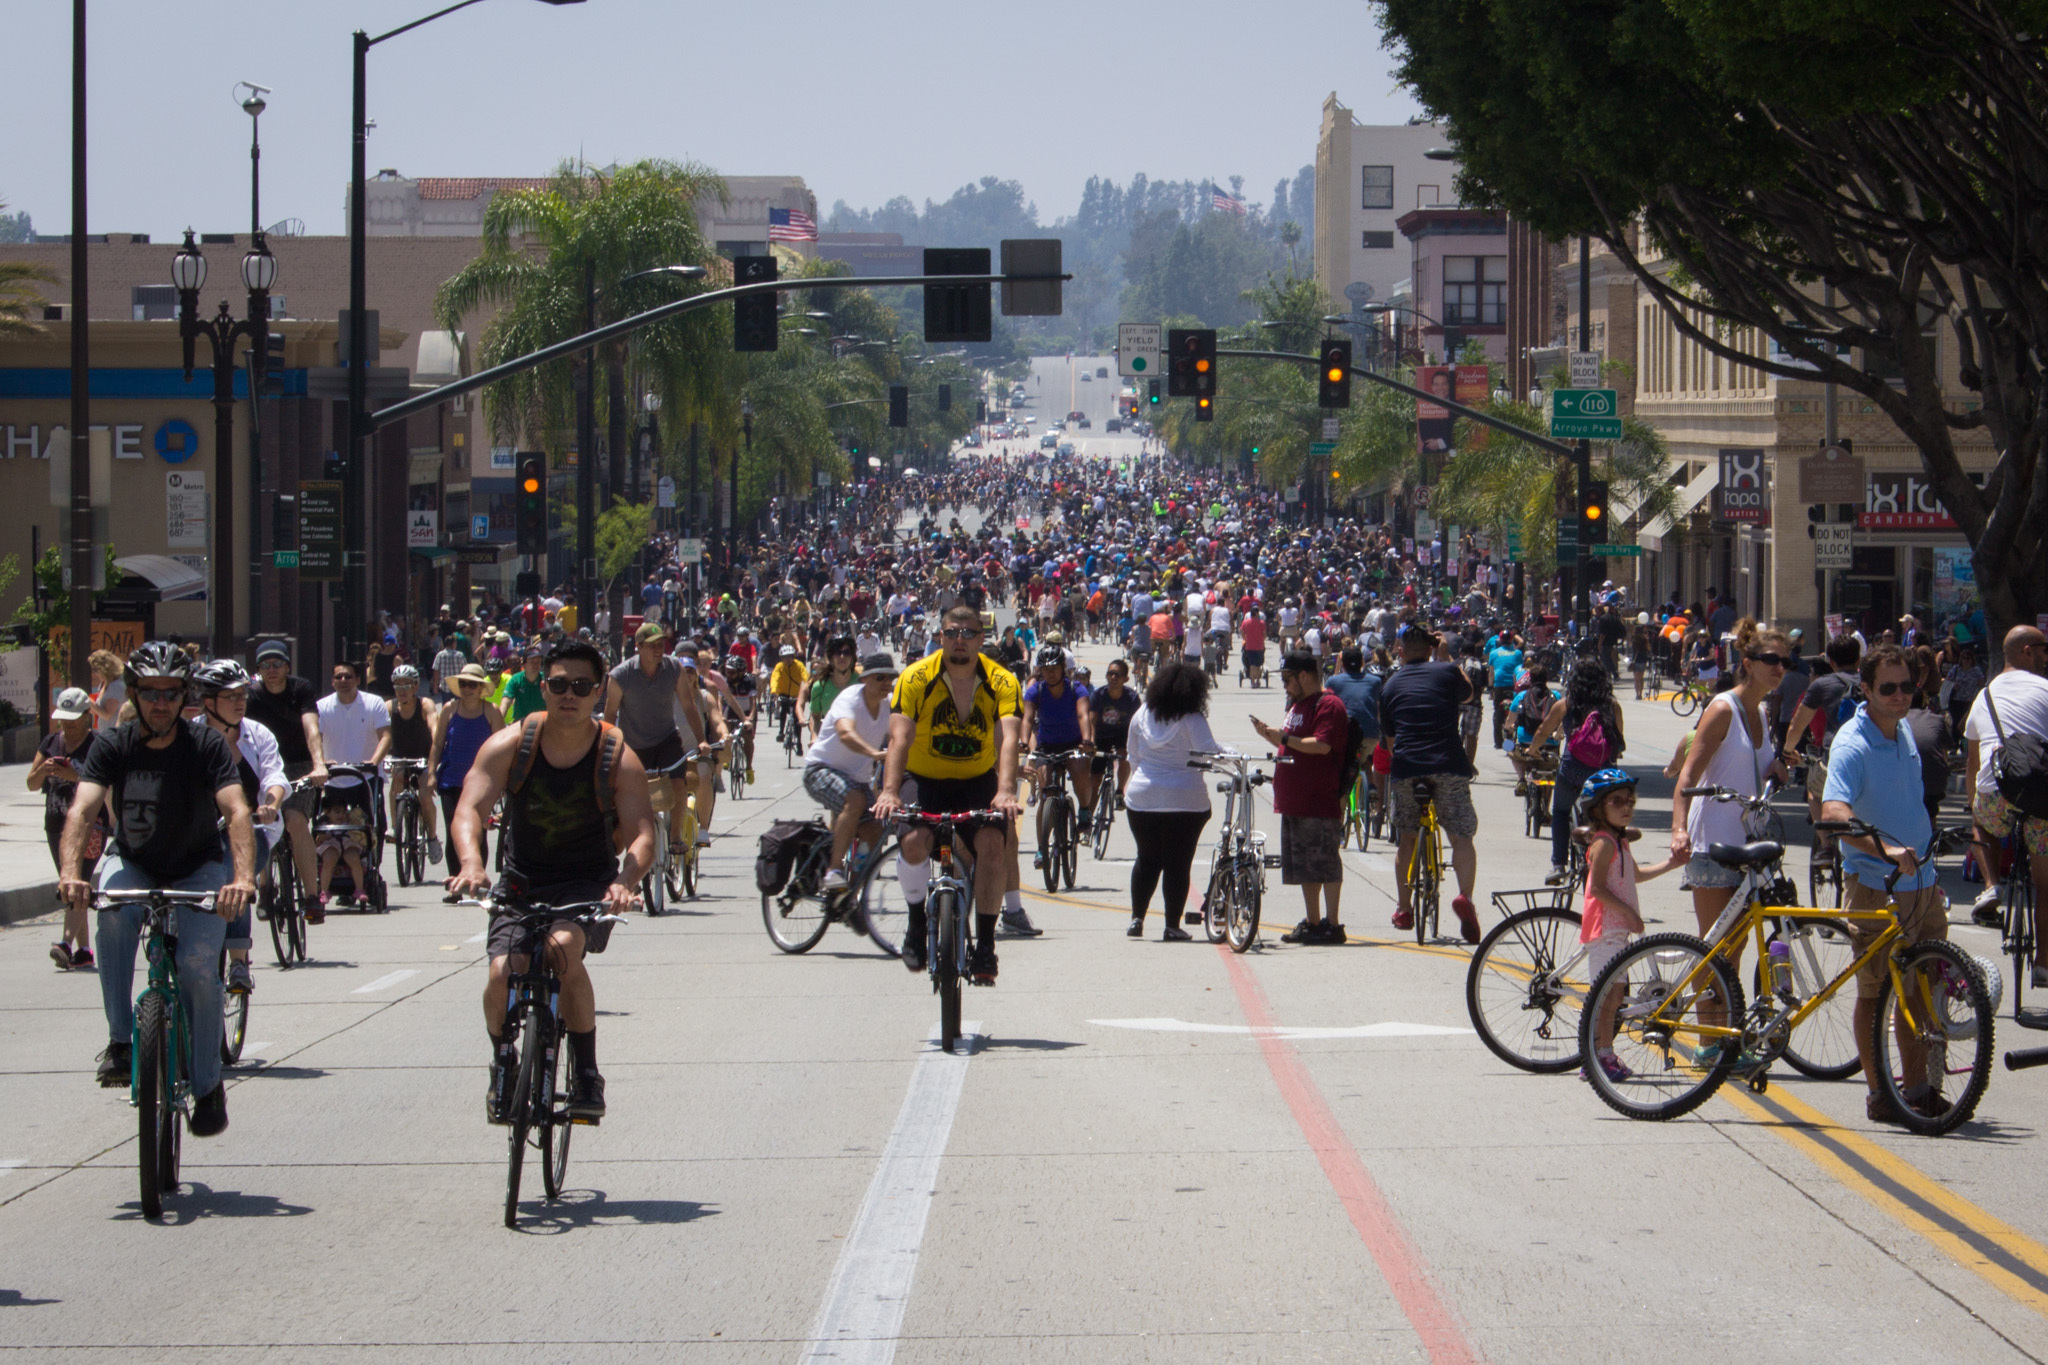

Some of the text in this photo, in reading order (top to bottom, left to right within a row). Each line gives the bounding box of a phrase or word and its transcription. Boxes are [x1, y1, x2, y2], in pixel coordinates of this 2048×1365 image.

[1573, 357, 1597, 365] DO NOT
[1573, 368, 1597, 377] BLOCK
[1586, 399, 1605, 411] 110
[1553, 423, 1619, 434] Arroyo Pkwy
[169, 494, 184, 503] 180
[1724, 490, 1760, 508] tapa
[169, 503, 183, 511] 181
[1863, 515, 1935, 525] CANTINA
[168, 529, 184, 538] 687
[410, 527, 434, 538] san
[1817, 529, 1850, 540] DO NOT
[1817, 544, 1850, 555] BLOCK
[103, 631, 135, 654] DATA
